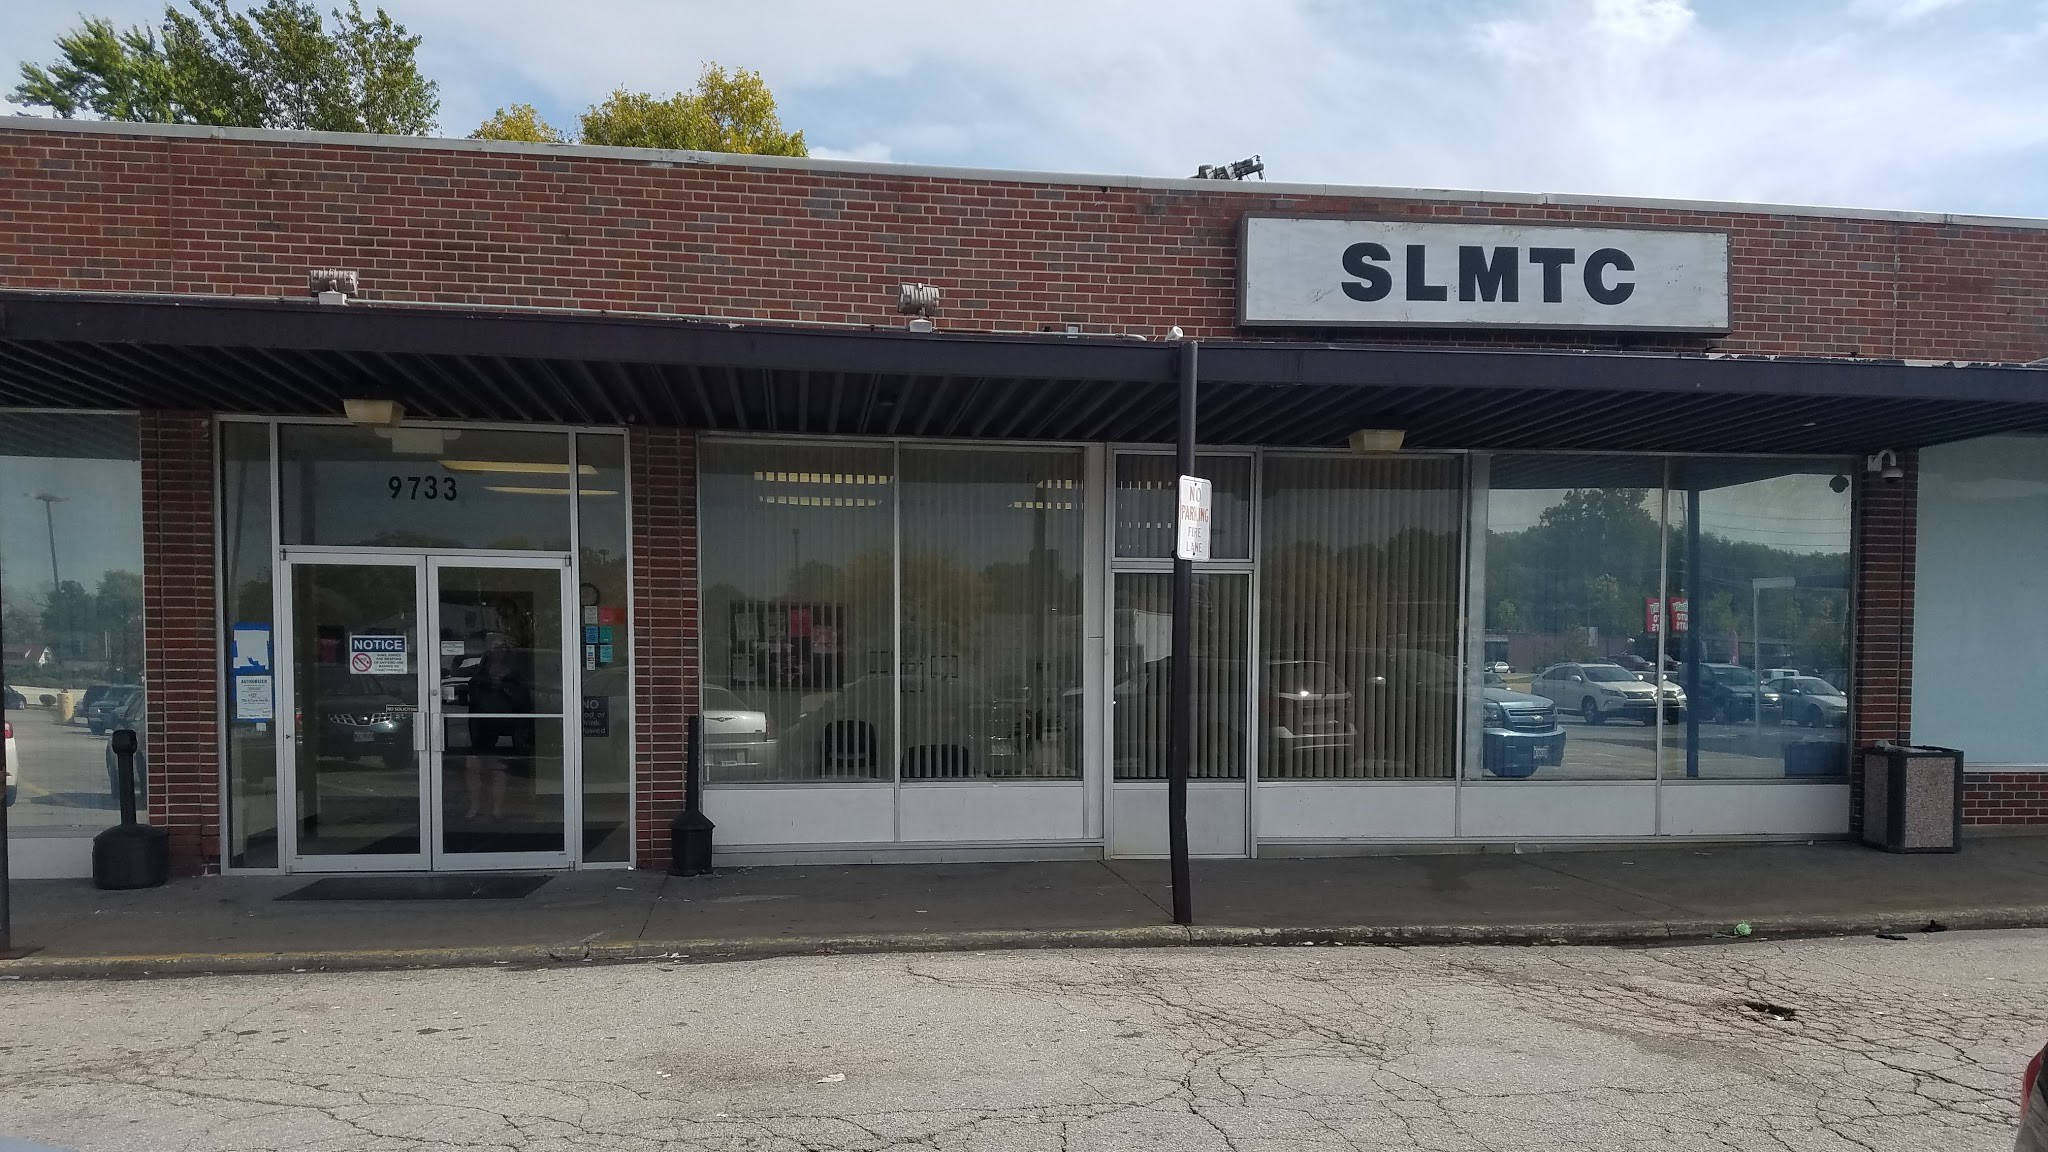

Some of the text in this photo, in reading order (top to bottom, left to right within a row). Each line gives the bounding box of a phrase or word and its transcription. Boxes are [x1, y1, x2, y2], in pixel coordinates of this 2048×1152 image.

[1341, 242, 1636, 306] SLMTC
[388, 475, 457, 501] 9733
[1189, 486, 1202, 502] NO
[1181, 504, 1209, 522] PARKING
[1187, 526, 1202, 538] FIRE
[1185, 541, 1203, 553] LANE
[353, 639, 403, 650] NOTICE
[582, 700, 599, 709] NO
